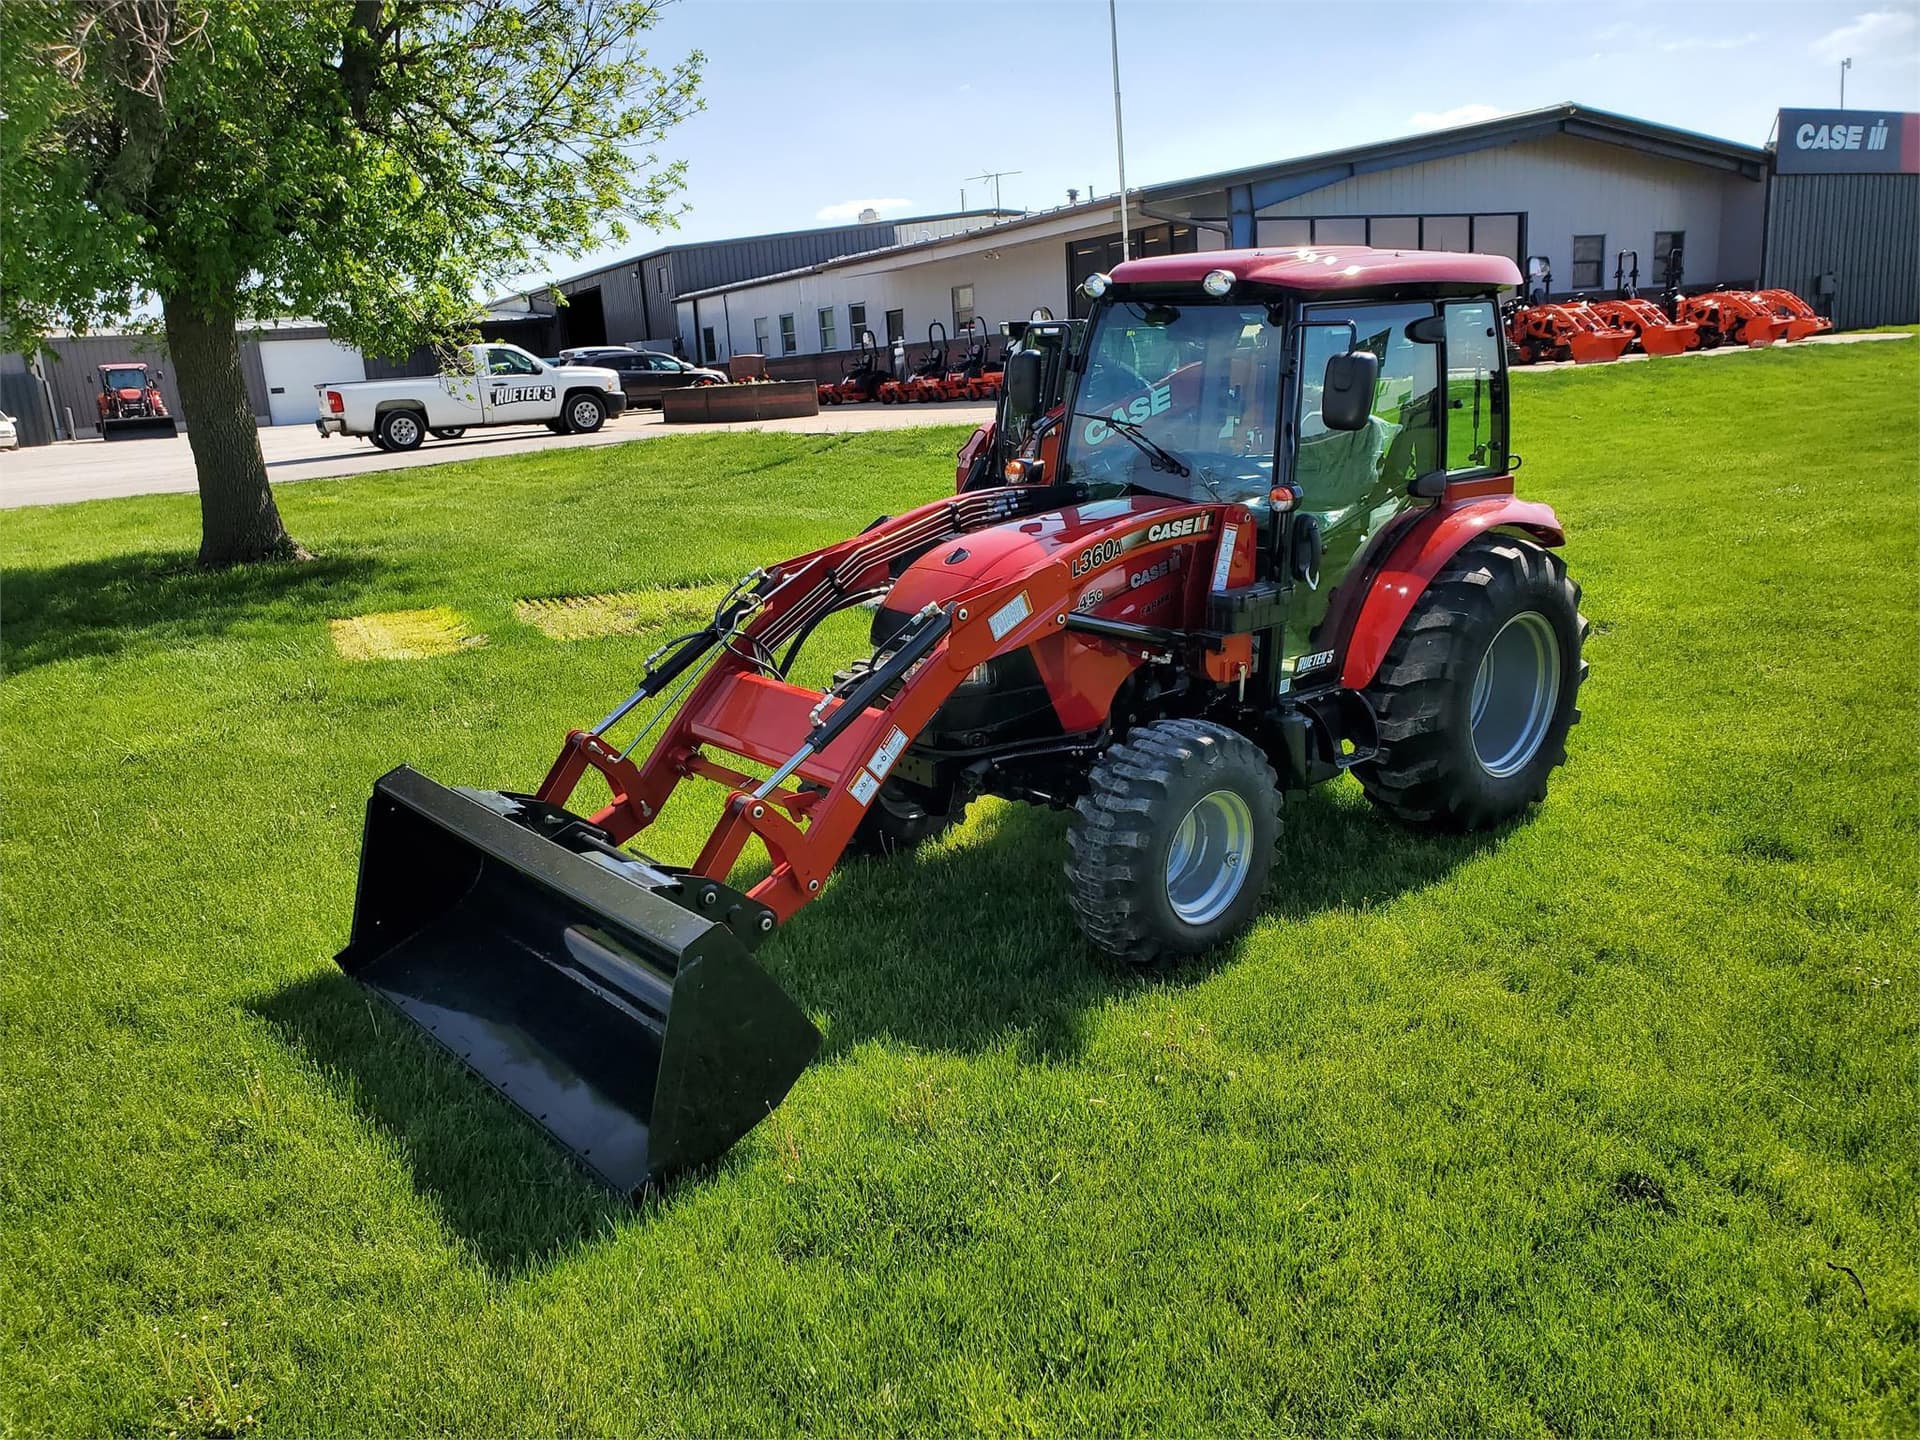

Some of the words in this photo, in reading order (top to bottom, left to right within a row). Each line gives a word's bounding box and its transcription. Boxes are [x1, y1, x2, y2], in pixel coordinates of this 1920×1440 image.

[1796, 123, 1864, 150] CASE
[495, 386, 553, 406] RUETER'S
[1084, 384, 1171, 445] CASE
[1148, 518, 1194, 542] CASE
[1071, 538, 1123, 579] L360A
[1130, 561, 1168, 588] CASE
